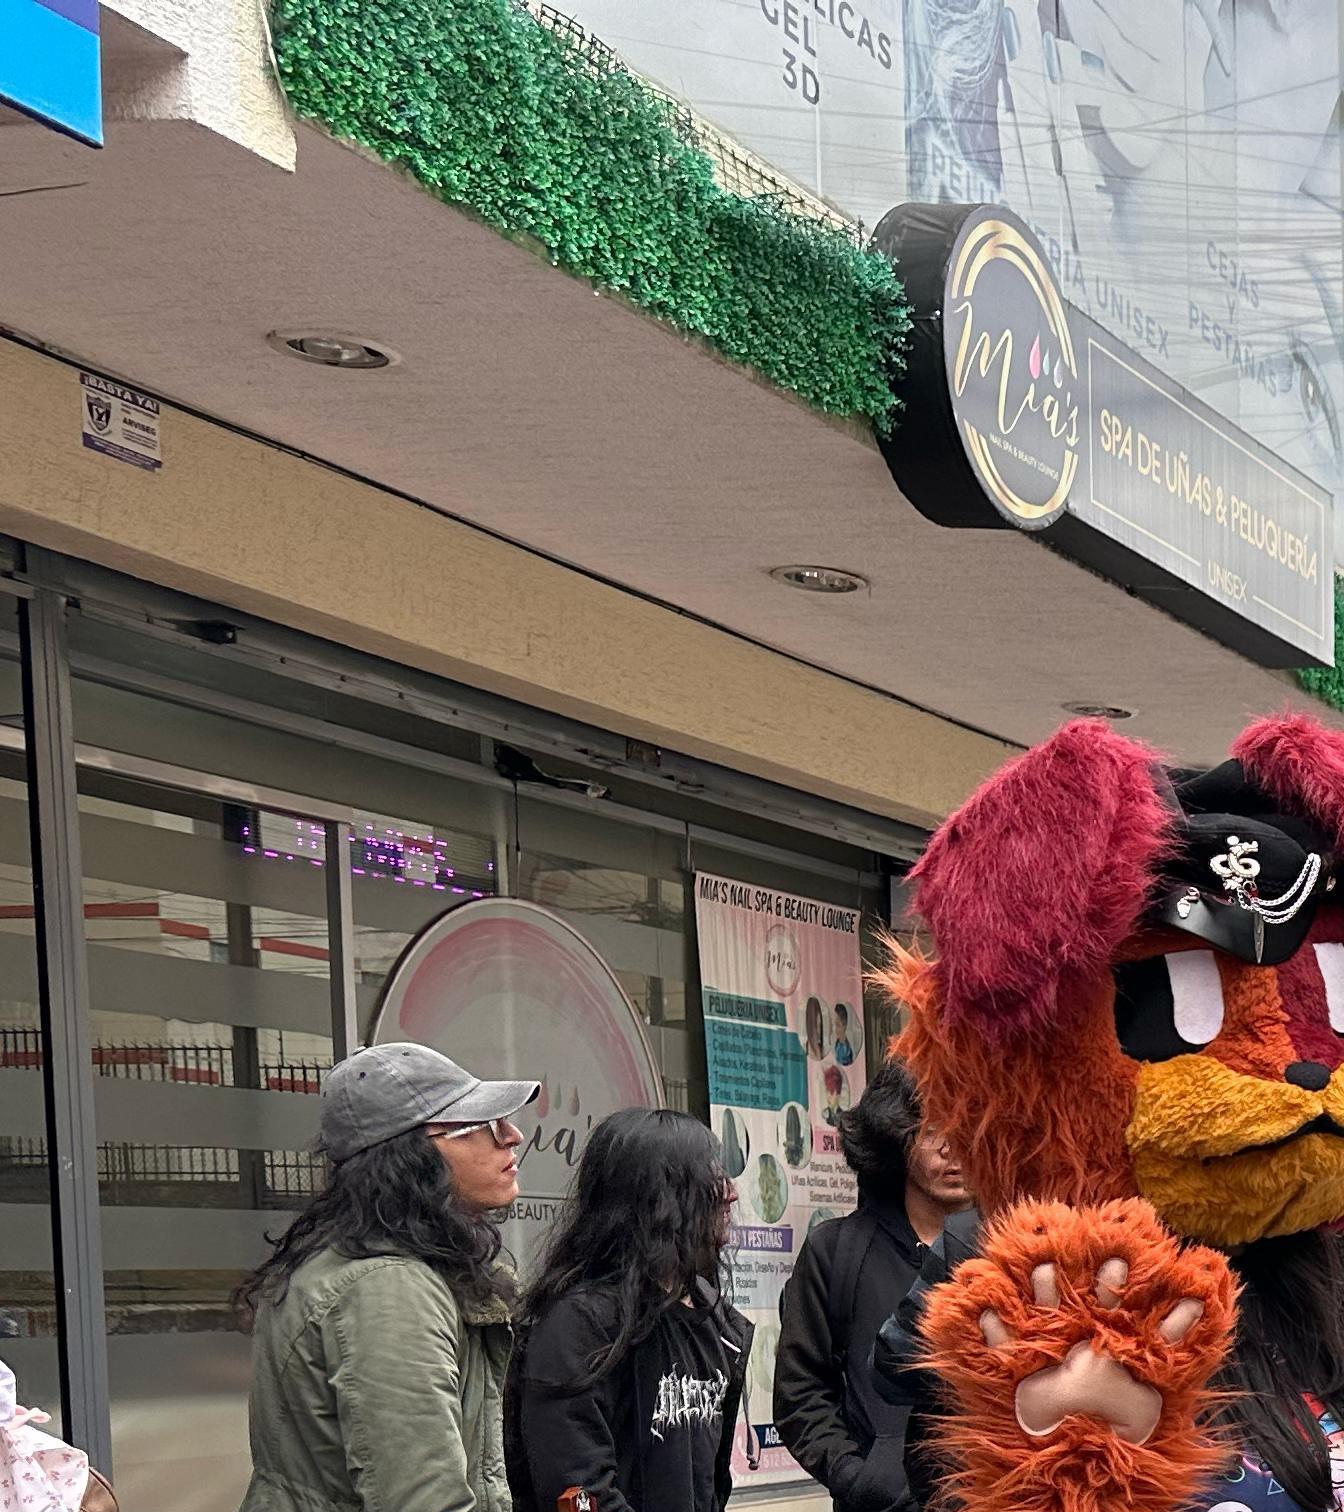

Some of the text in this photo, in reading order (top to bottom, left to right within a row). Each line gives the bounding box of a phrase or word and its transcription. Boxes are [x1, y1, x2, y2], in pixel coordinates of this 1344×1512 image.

[782, 47, 820, 105] 3D
[1207, 240, 1259, 309] CEJAS
[1096, 279, 1169, 358] UNISEX
[1227, 293, 1236, 325] Y
[954, 301, 1080, 448] Mia's
[1101, 409, 1318, 585] SPA DE UÑAS & PELUQUERÍA
[1208, 560, 1248, 603] UNISEX
[700, 876, 857, 934] MIA'S NAIL SPA & BEAUTY LOUNGE
[508, 1203, 557, 1221] BEAUTY
[747, 1228, 783, 1249] PESTAÑAS
